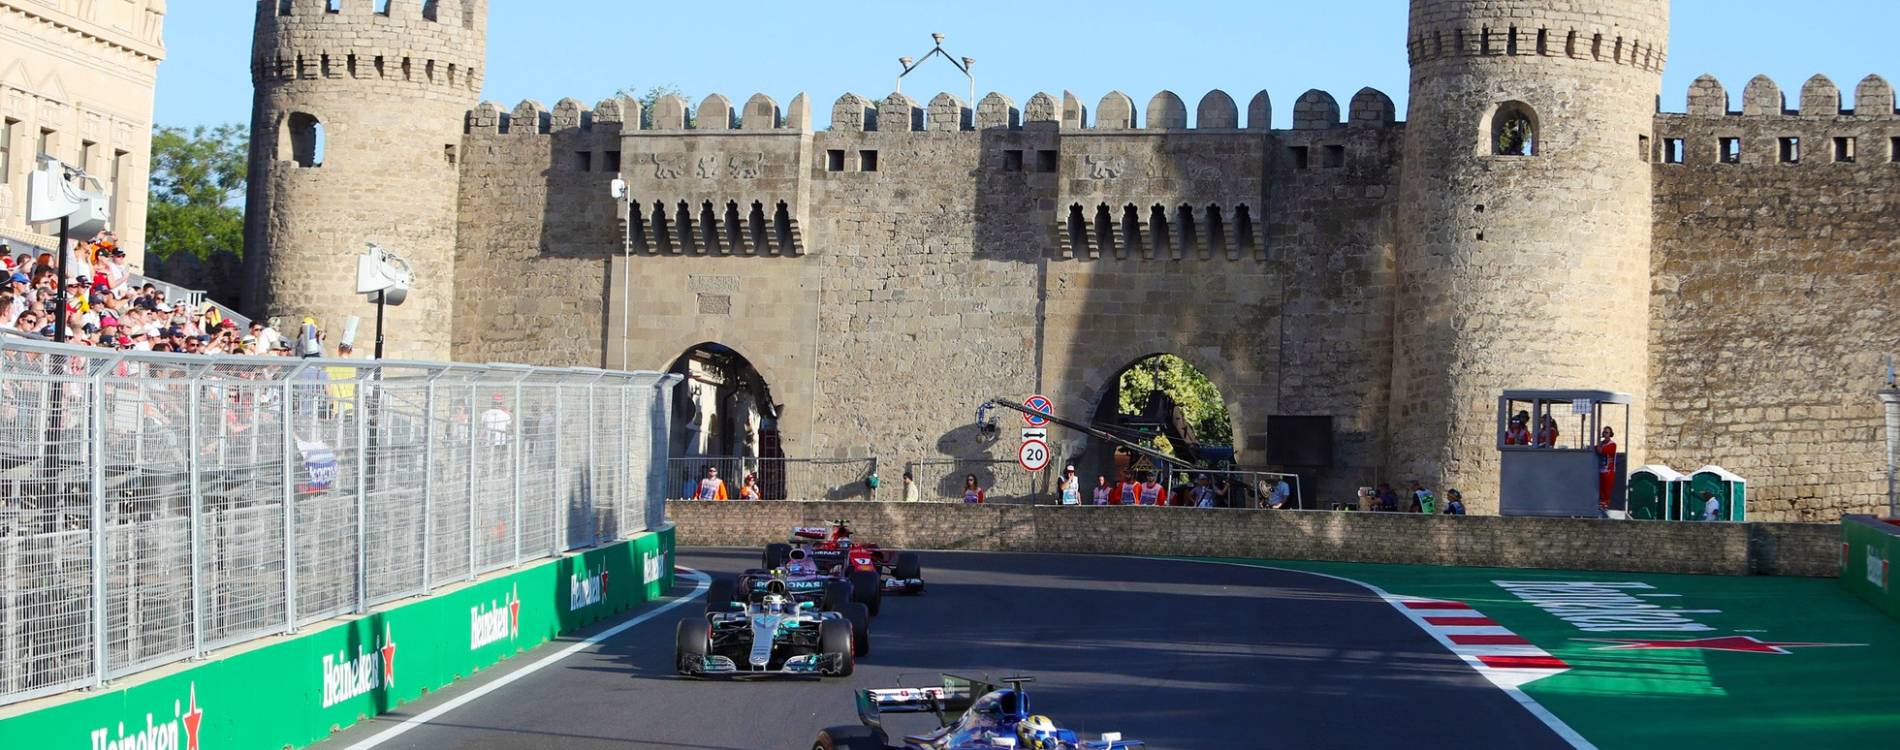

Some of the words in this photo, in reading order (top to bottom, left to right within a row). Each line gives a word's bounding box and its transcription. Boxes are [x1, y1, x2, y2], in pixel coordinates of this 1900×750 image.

[1026, 448, 1043, 461] 20
[570, 569, 600, 611] Heineken
[470, 599, 509, 650] Heineken
[322, 644, 380, 709] Heineken
